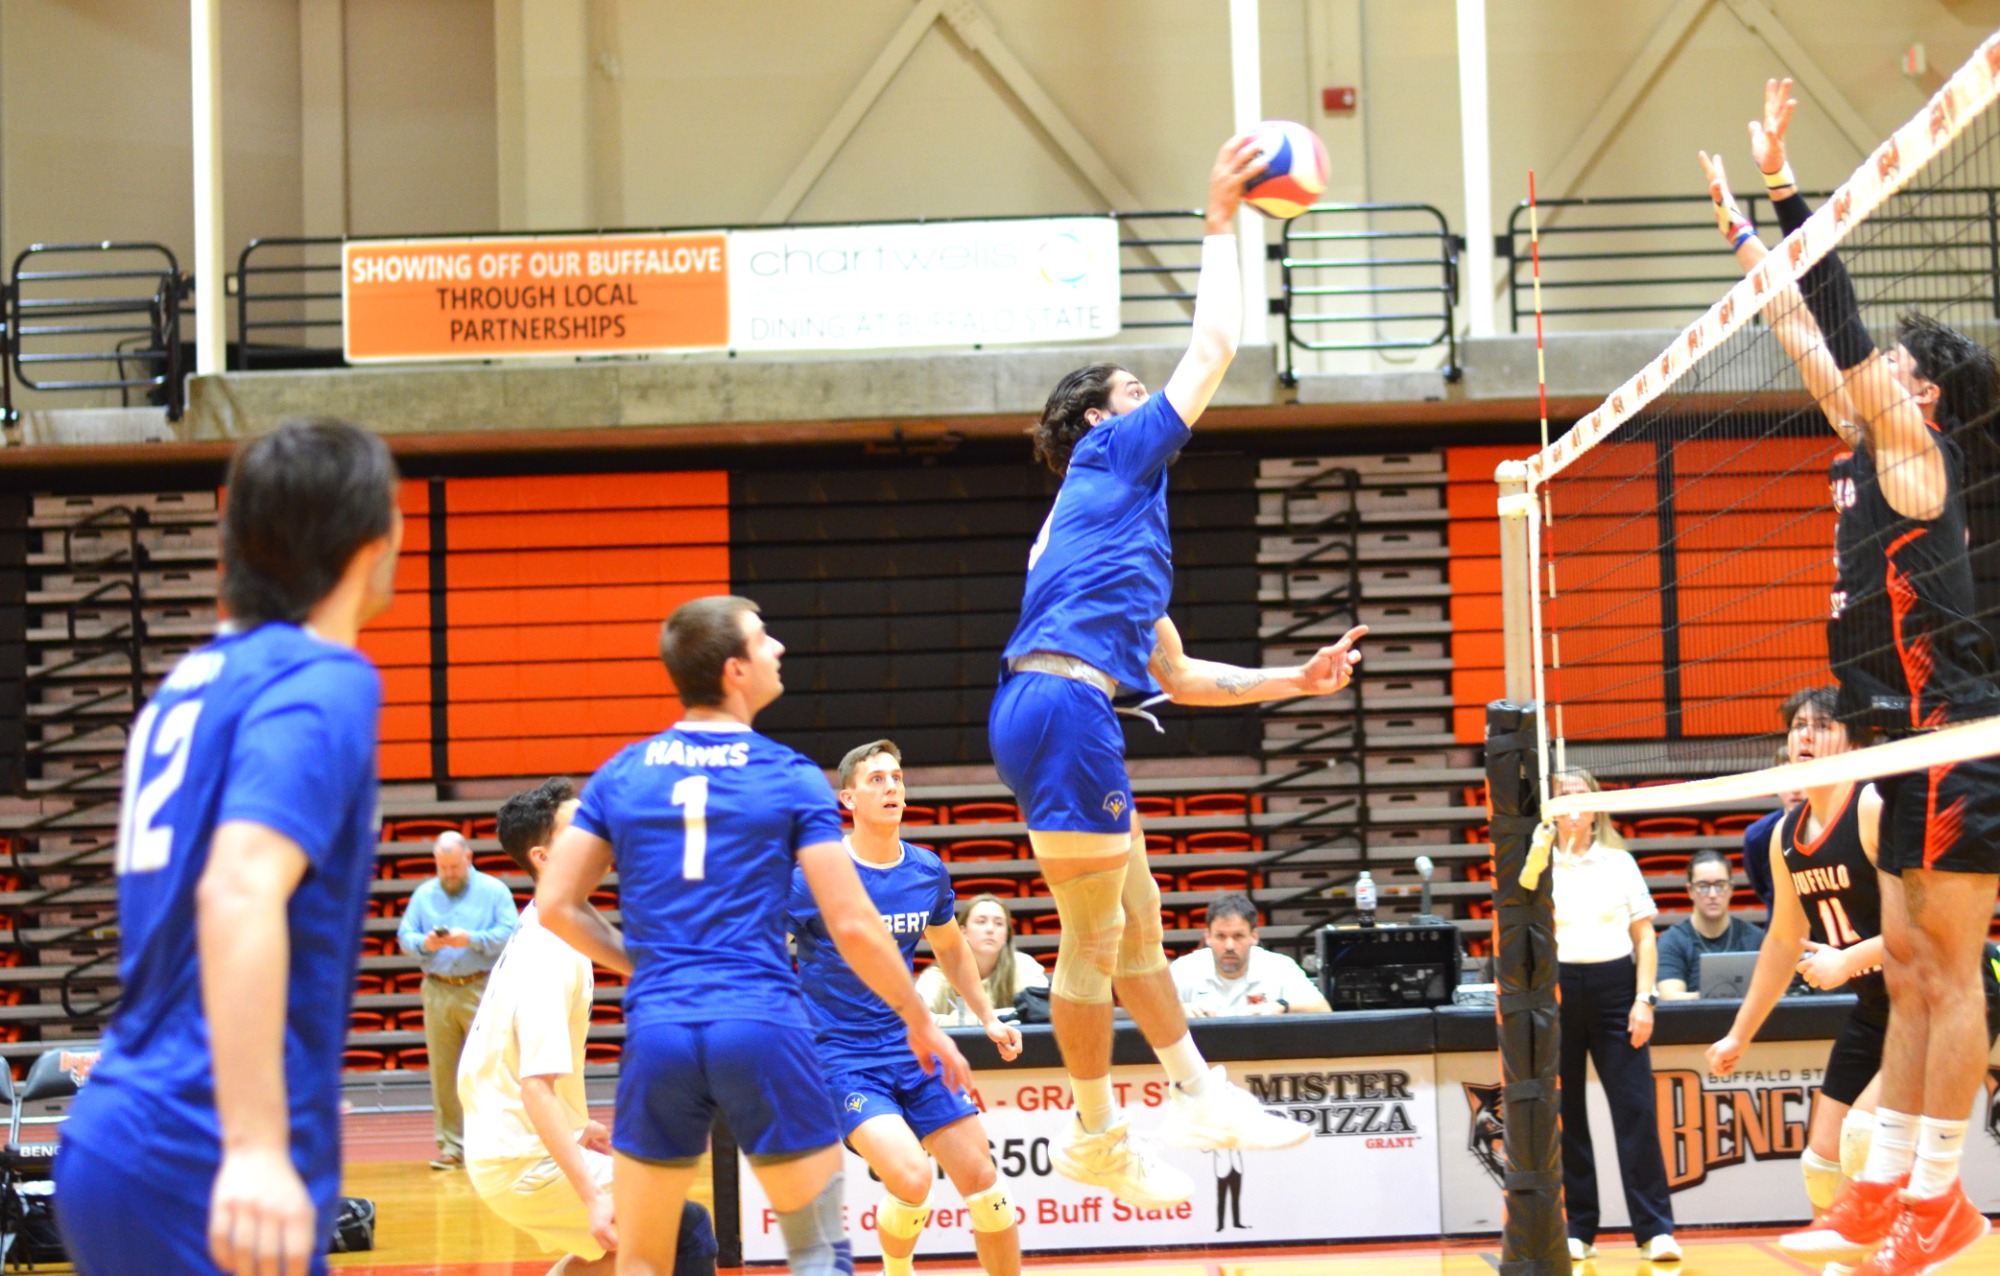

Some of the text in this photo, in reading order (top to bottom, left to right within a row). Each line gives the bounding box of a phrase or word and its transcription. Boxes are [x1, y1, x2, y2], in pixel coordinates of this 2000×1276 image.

[352, 246, 722, 284] SHOWING OFF OUR BUFFALOVE
[750, 238, 1017, 277] chartwells
[436, 283, 639, 310] THROUGH LOCAL
[450, 314, 626, 342] PARTNERSHIPS
[751, 306, 1102, 341] DINING AT BUFFALO STATE
[644, 739, 751, 768] HAWKS
[115, 698, 205, 876] 12
[671, 774, 710, 880] 1
[1245, 1069, 1415, 1106] MISTER
[1708, 1069, 1792, 1084] BUFFALO
[1016, 1083, 1132, 1112] GRT
[1288, 1102, 1416, 1137] PIZZA
[1364, 1136, 1415, 1149] GRANT
[1038, 1197, 1103, 1224] Buff
[1112, 1199, 1193, 1223] State
